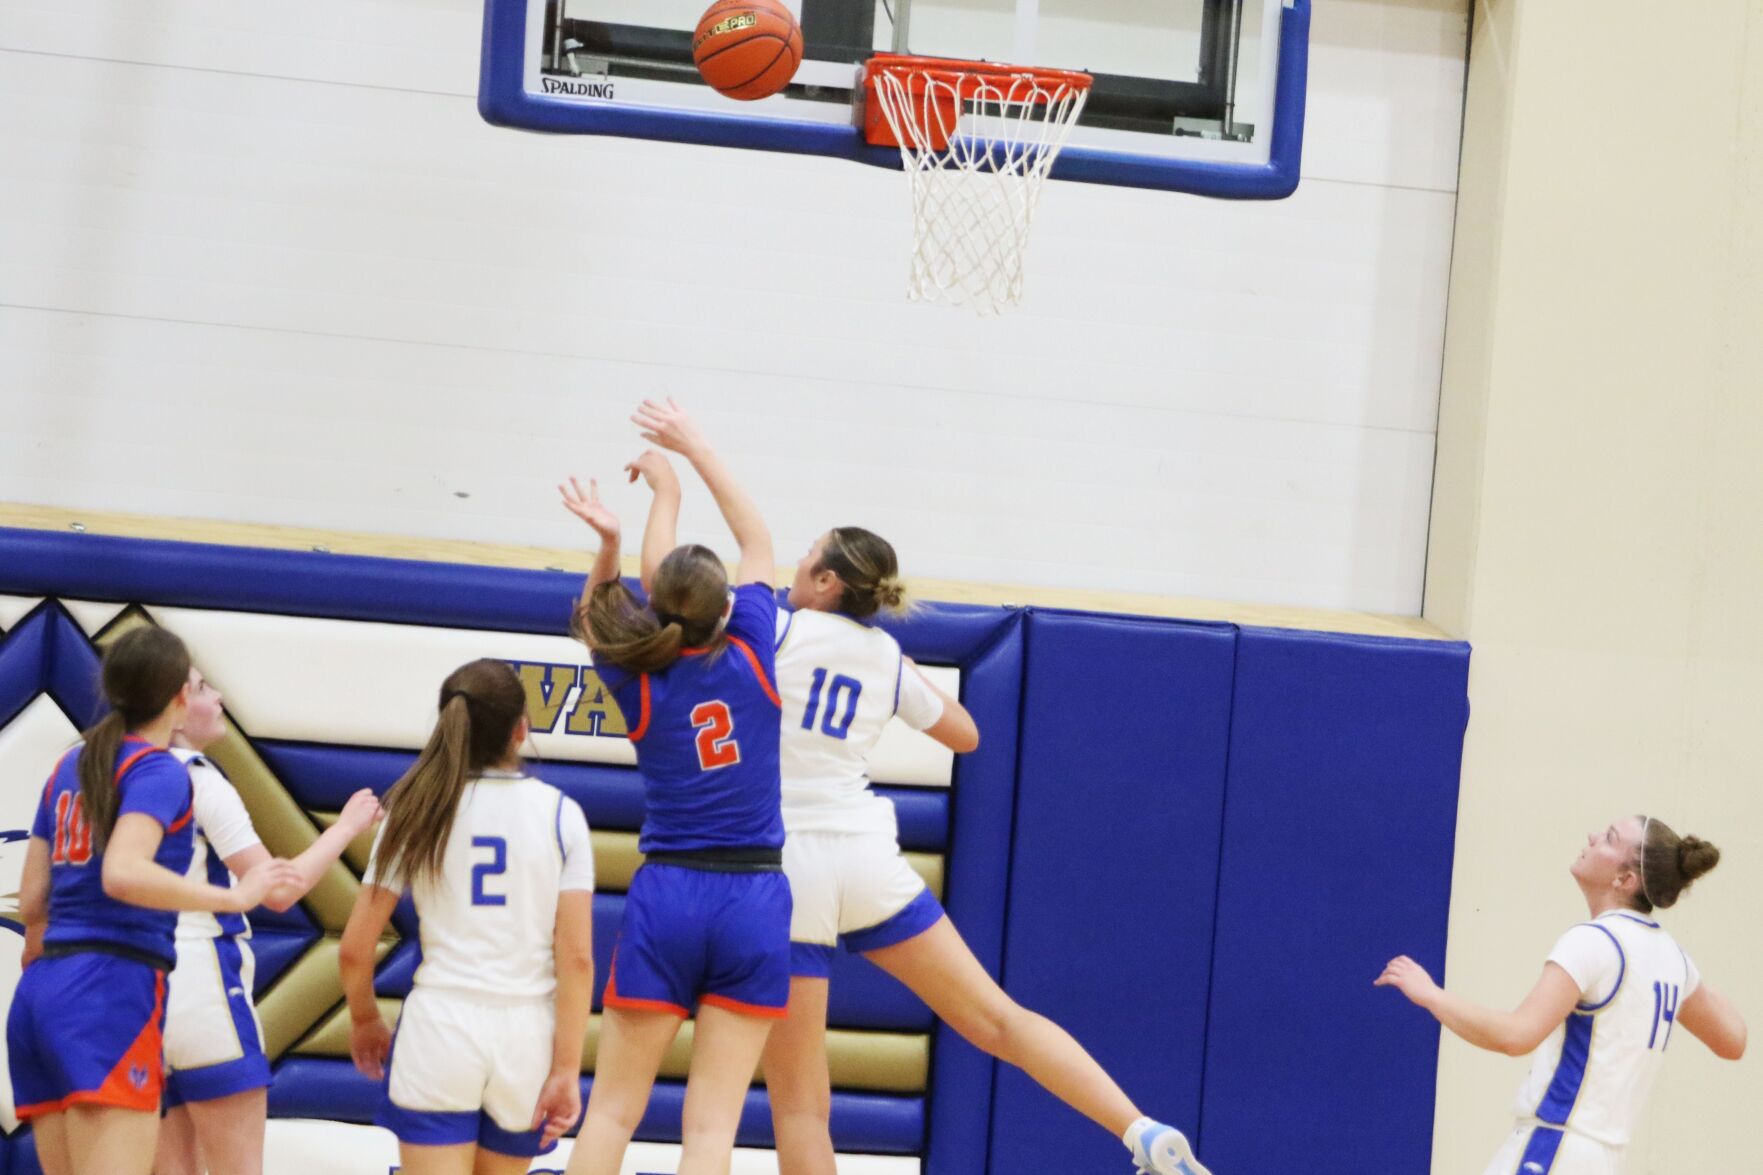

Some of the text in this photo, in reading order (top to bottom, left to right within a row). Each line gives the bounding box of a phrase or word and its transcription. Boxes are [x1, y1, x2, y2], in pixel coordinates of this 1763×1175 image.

[729, 15, 756, 29] PRO
[541, 77, 614, 99] SPALDING
[690, 699, 741, 770] 2
[800, 667, 862, 739] 10
[53, 789, 93, 865] 10
[472, 836, 506, 906] 2
[1648, 980, 1678, 1052] 14
